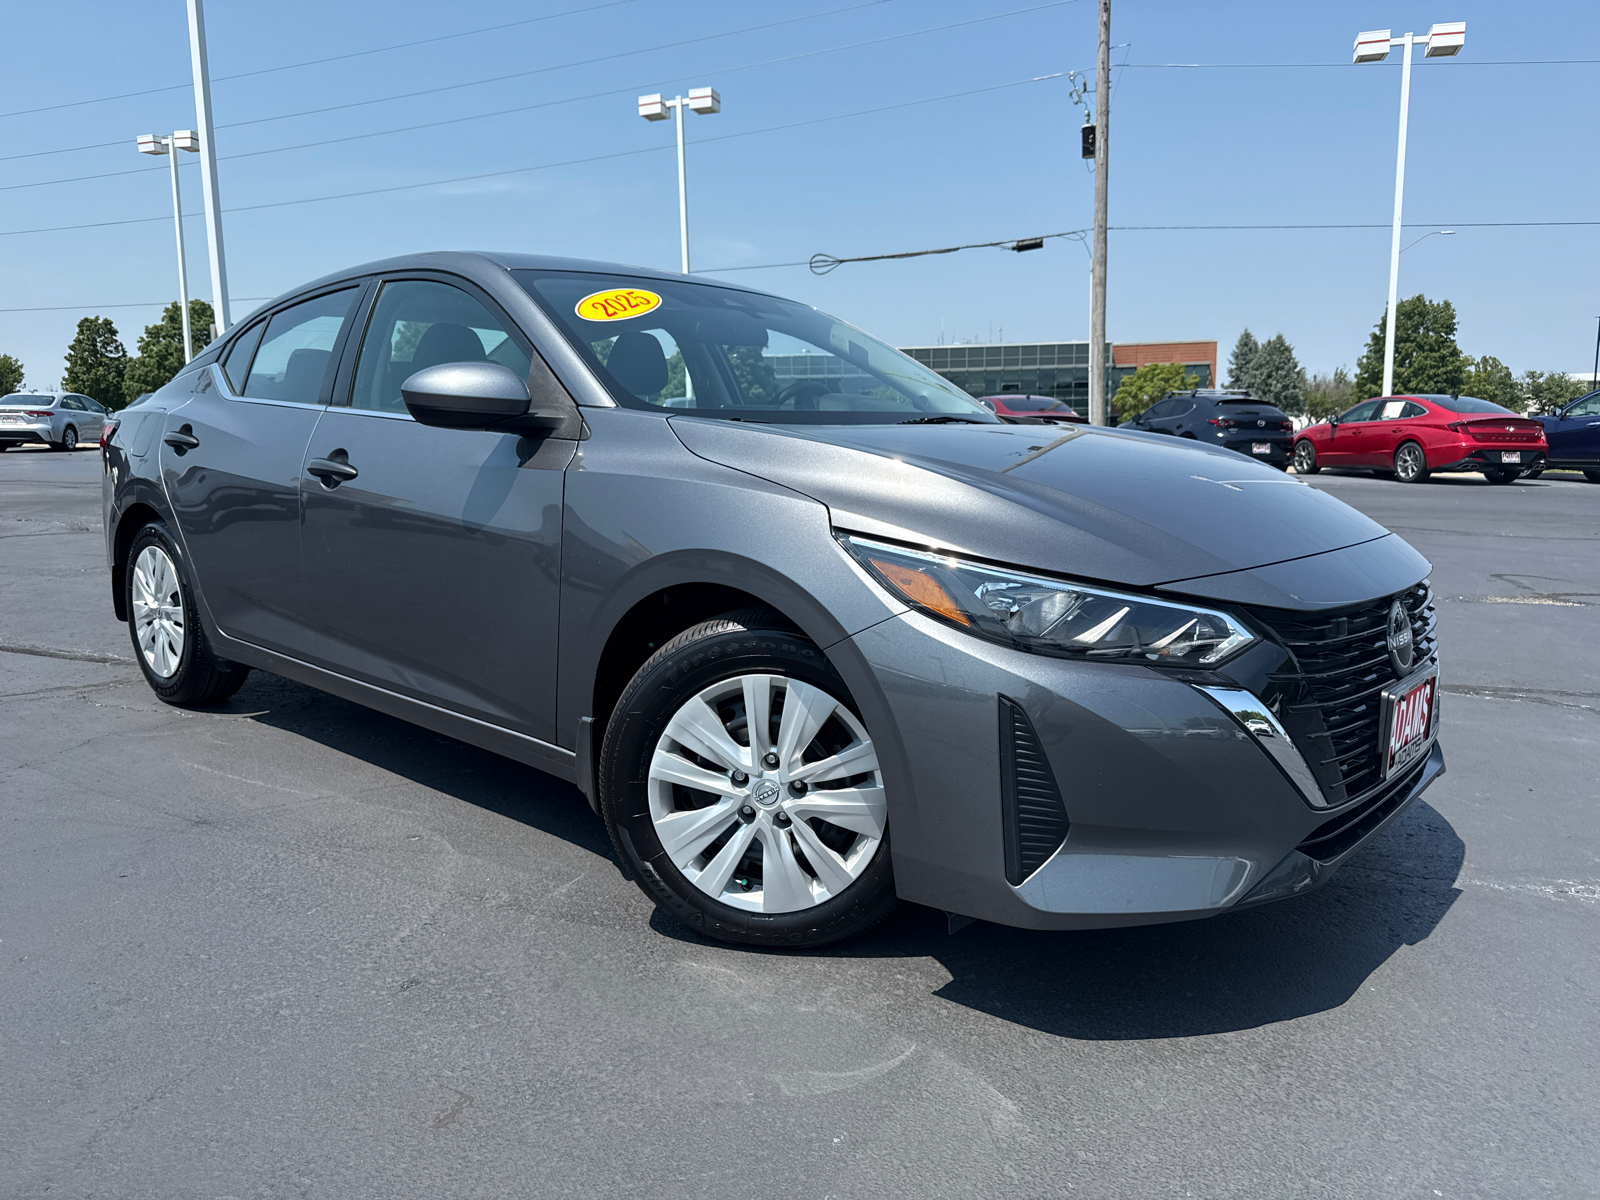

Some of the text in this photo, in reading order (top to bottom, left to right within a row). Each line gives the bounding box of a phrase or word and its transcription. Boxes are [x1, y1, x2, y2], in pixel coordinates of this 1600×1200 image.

[592, 291, 651, 317] 2025
[1389, 630, 1411, 649] NISS
[1390, 684, 1431, 755] ADAMS
